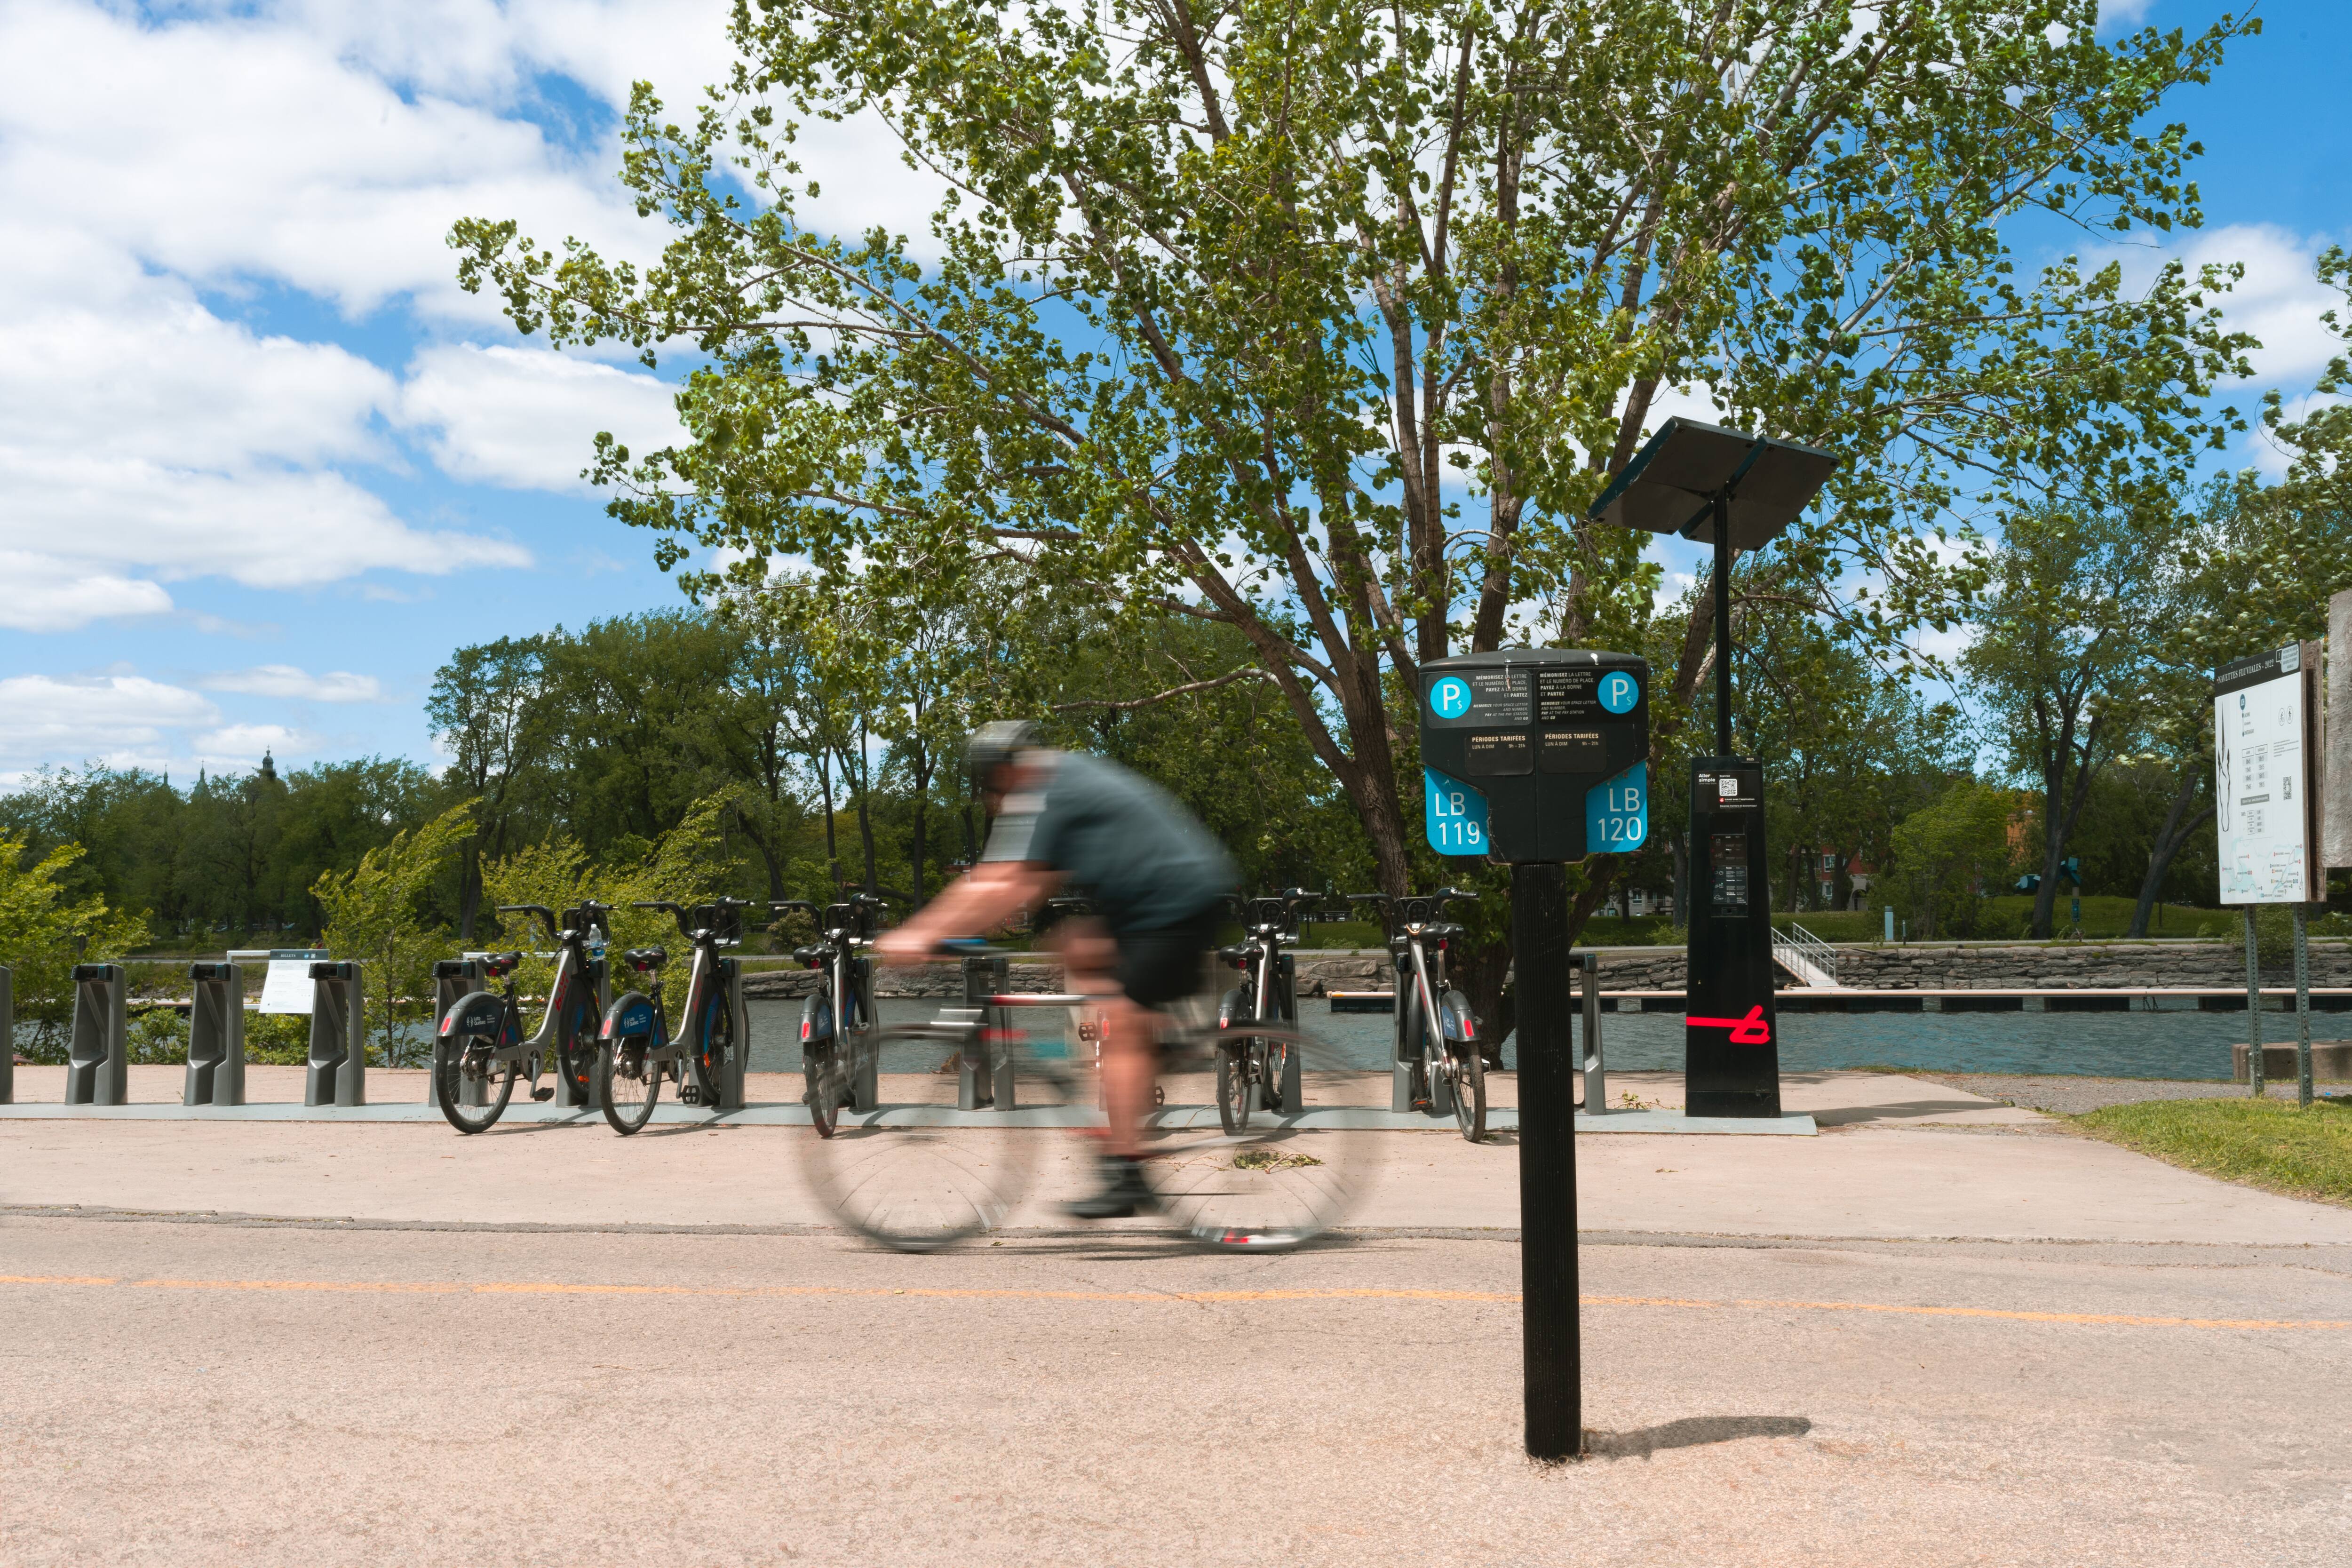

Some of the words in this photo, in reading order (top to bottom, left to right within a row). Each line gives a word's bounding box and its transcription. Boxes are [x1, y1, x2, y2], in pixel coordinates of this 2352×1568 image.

[2218, 670, 2238, 683] NAVETTES
[2239, 663, 2261, 677] FLUVIALES
[2265, 659, 2274, 669] 2022
[1443, 684, 1460, 711] P
[1613, 679, 1631, 706] P
[1435, 792, 1466, 816] LB
[1609, 788, 1640, 812] LB
[1439, 821, 1480, 845] 119
[1598, 817, 1642, 841] 120
